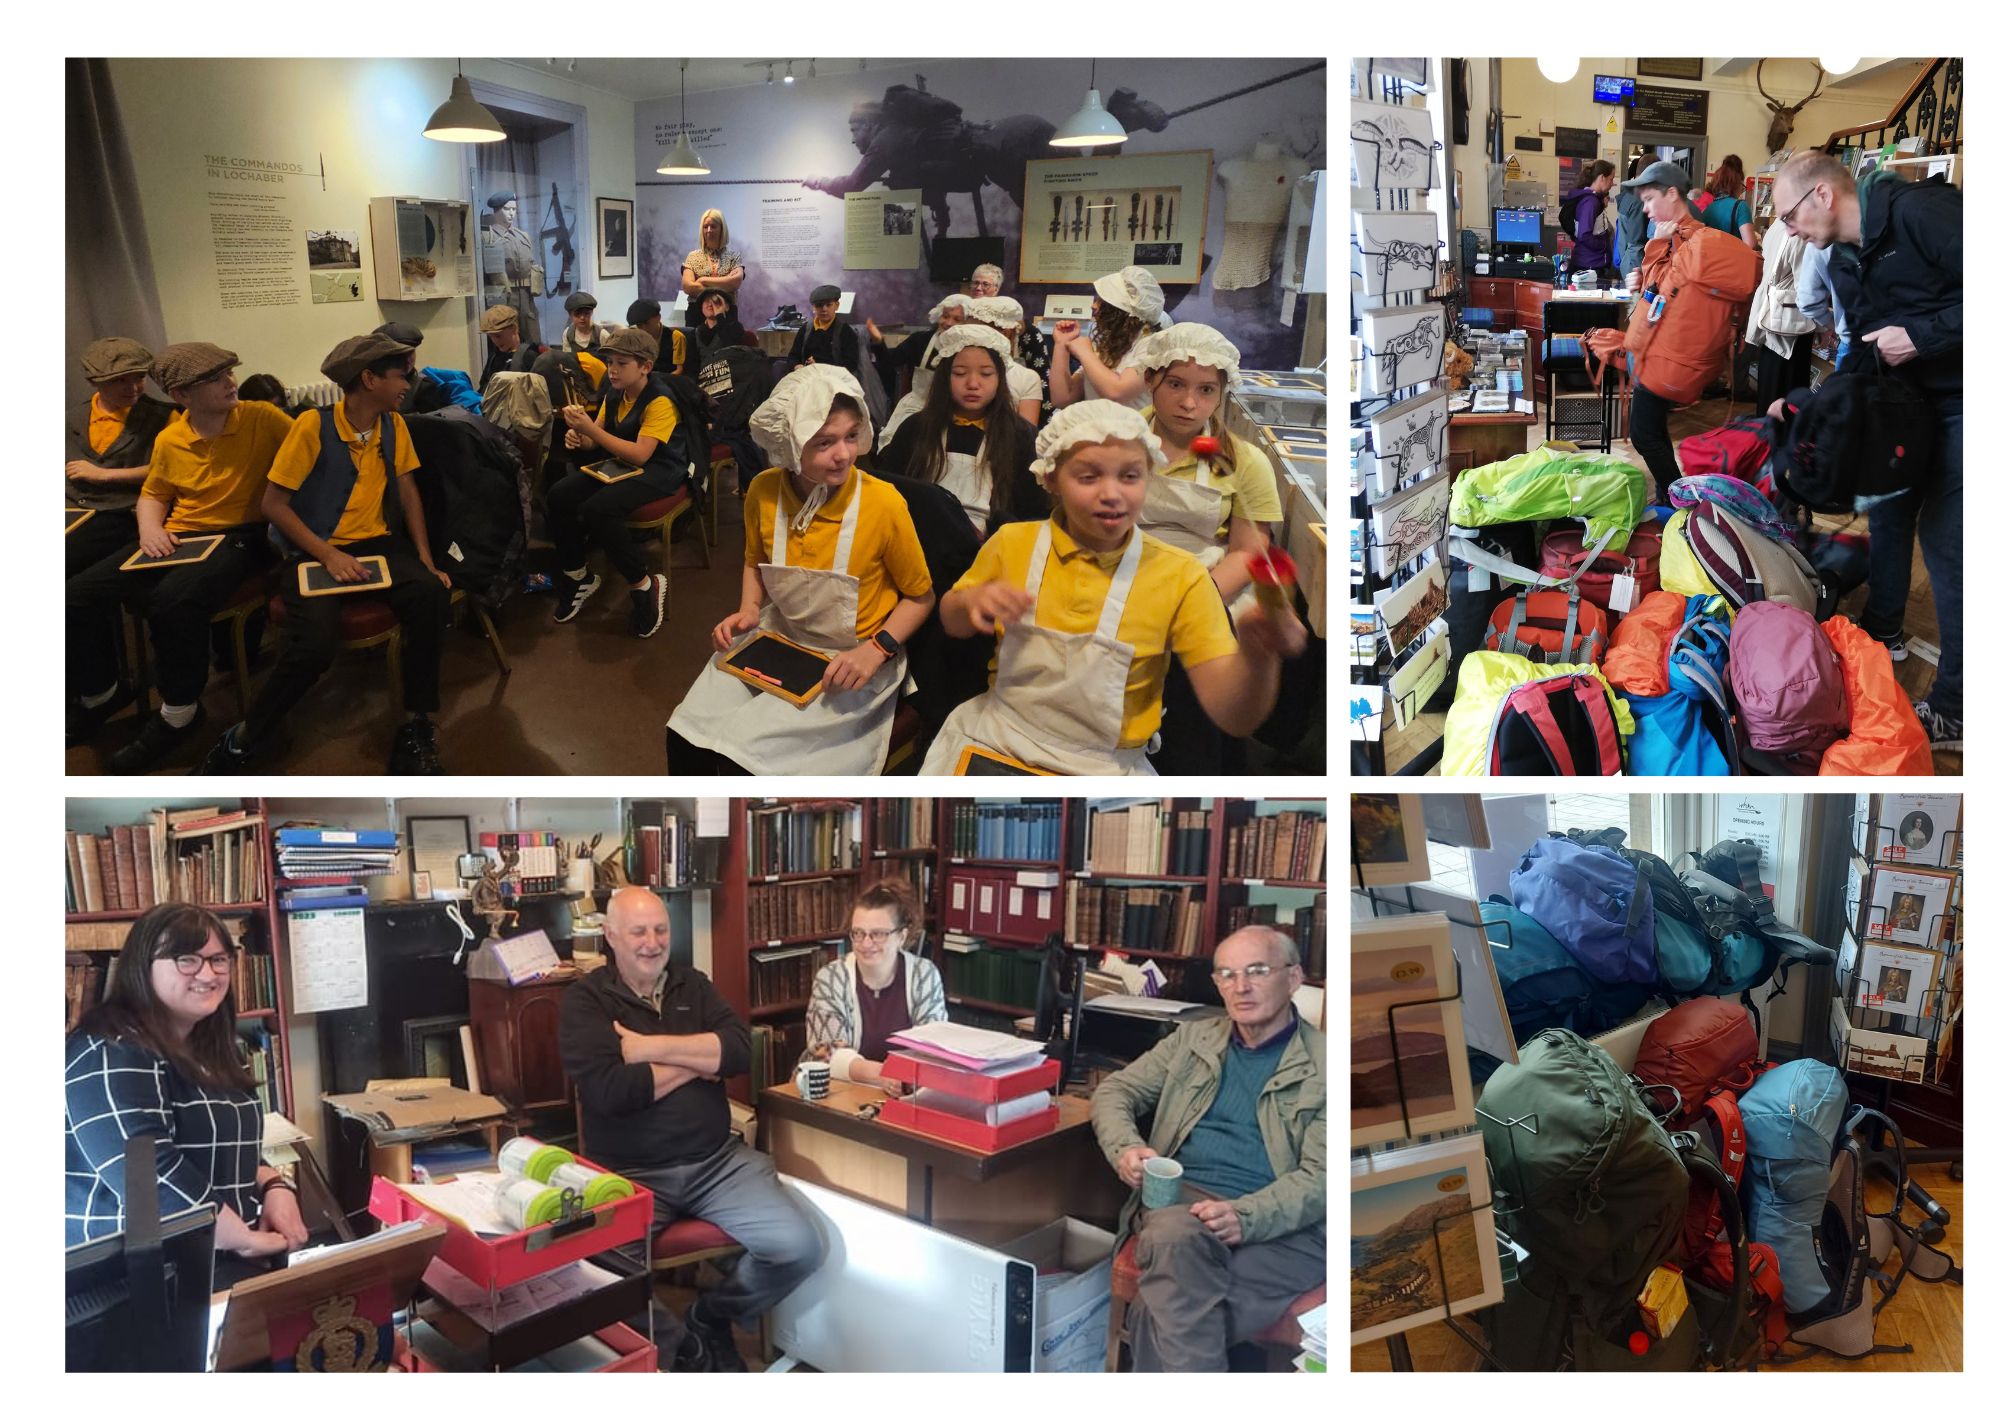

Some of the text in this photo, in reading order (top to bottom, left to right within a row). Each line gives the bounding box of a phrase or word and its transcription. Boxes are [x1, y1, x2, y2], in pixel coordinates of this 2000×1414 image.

[204, 154, 304, 173] THE COMMANDOS
[207, 169, 284, 183] IN LOCHABER
